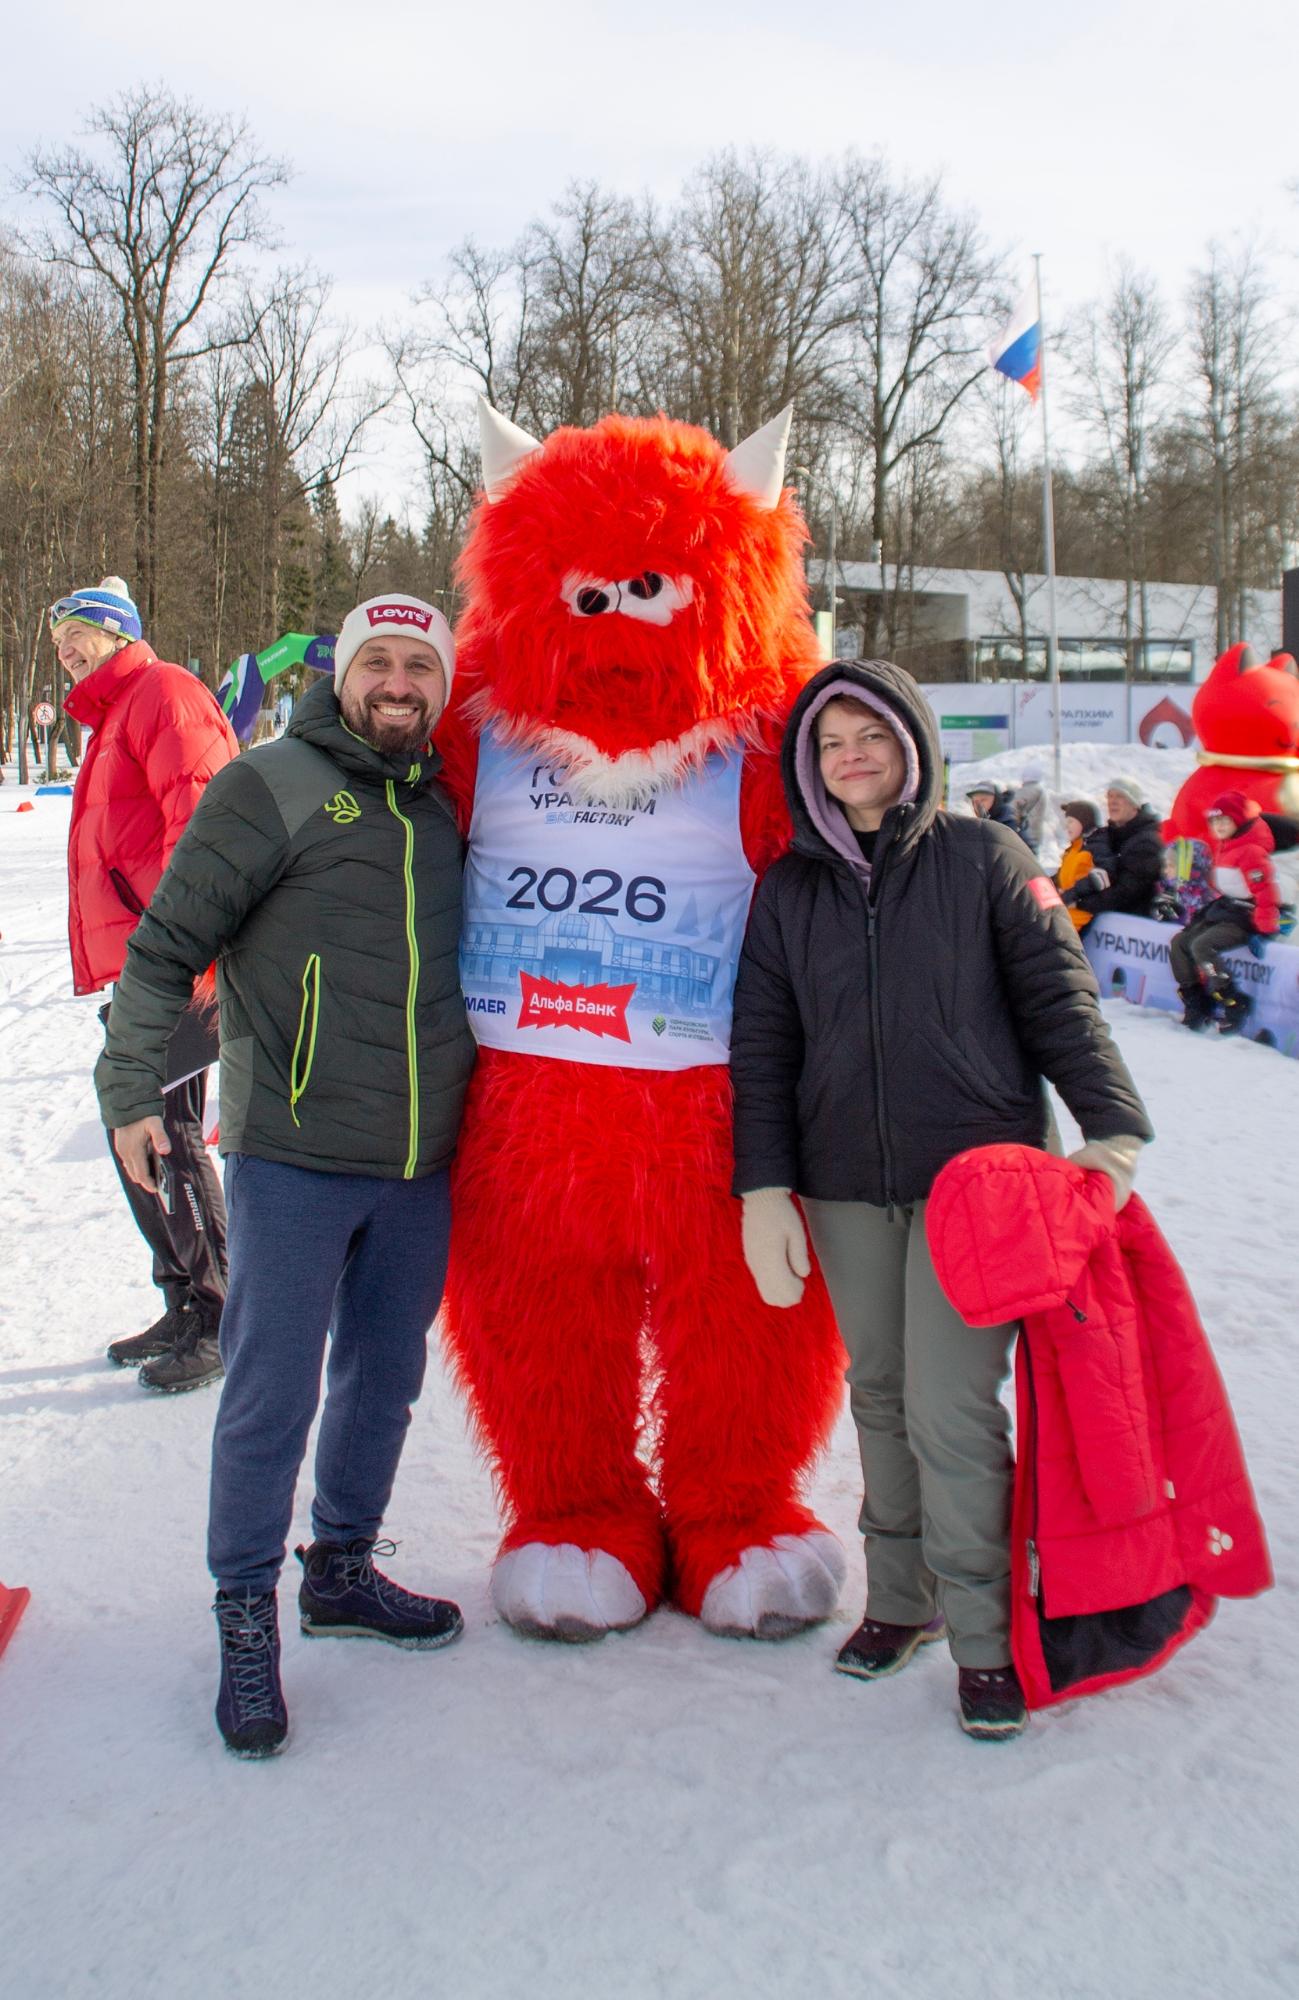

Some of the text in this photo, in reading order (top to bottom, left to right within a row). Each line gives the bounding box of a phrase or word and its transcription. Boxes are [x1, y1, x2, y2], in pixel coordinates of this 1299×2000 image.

[505, 866, 667, 923] 2026
[1094, 931, 1171, 964] УРАЛХИ
[1224, 957, 1276, 986] ACTORY
[464, 997, 507, 1015] MAER
[529, 992, 617, 1017] Альфа Банк
[183, 1183, 204, 1231] noname
